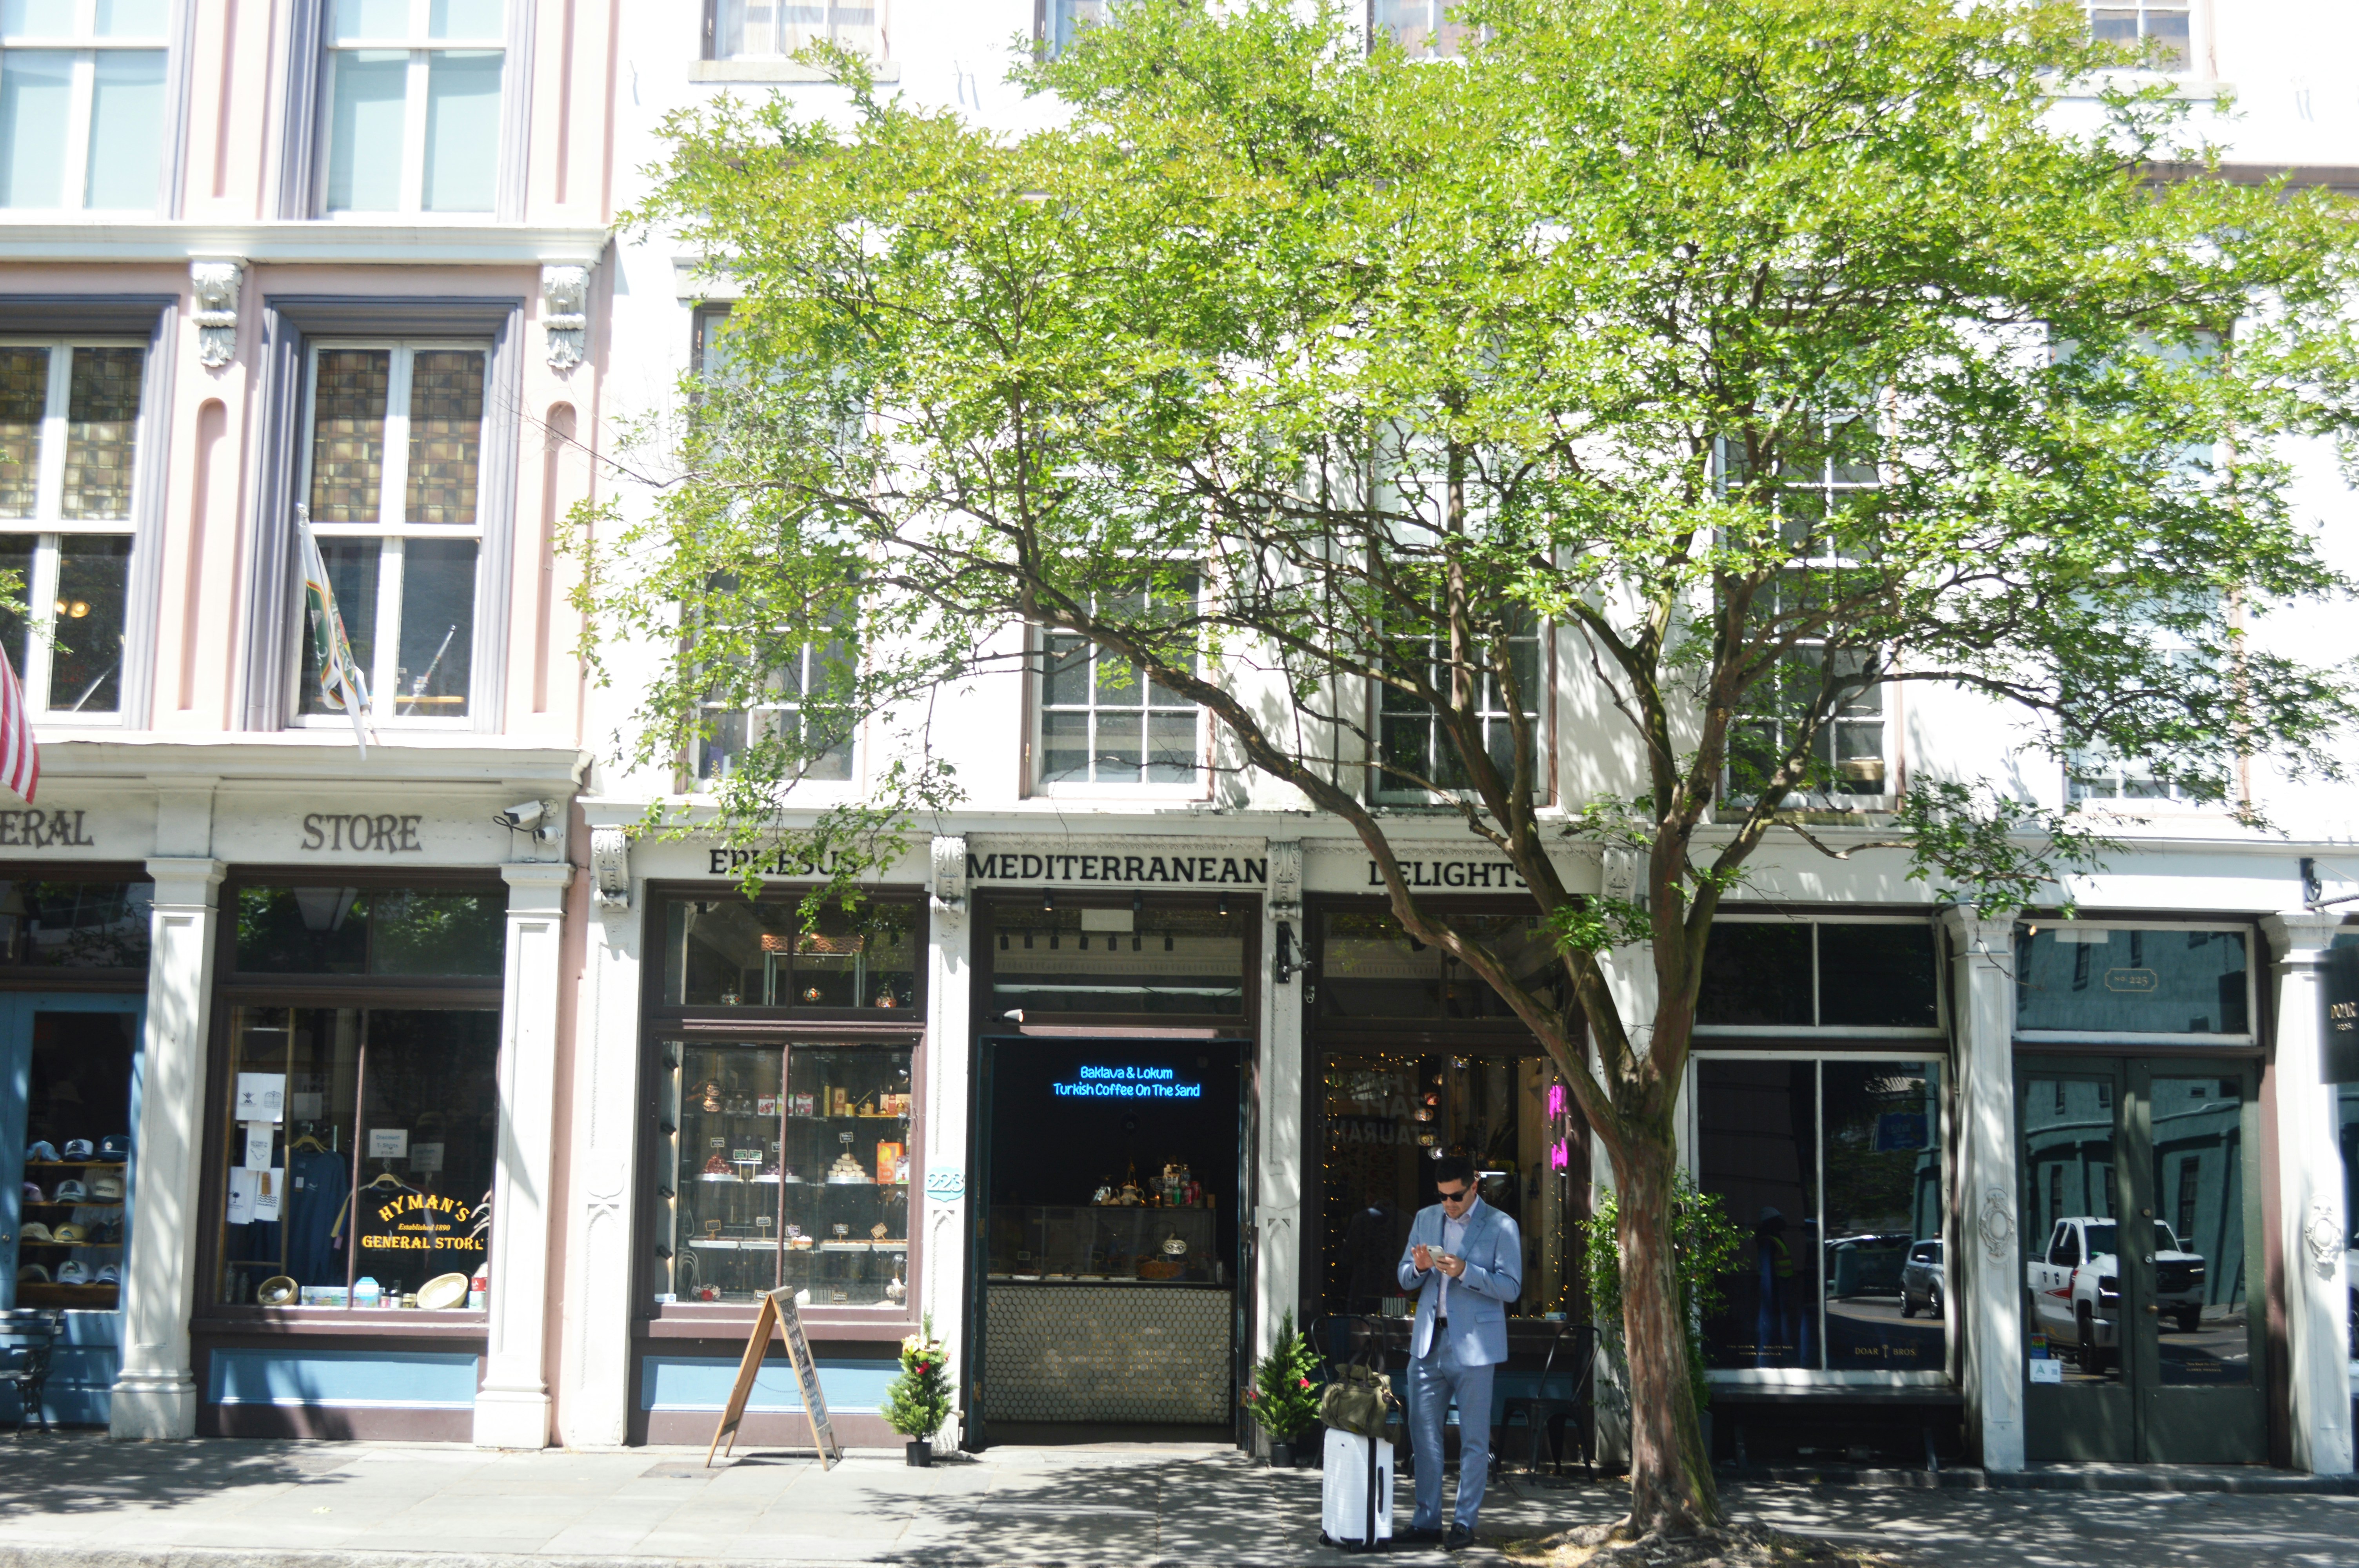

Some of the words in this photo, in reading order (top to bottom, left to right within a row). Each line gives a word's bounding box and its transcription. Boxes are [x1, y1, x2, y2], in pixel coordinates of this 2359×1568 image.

[301, 813, 422, 854] STORE
[966, 854, 1267, 883] MEDITERRANEAN
[2129, 976, 2149, 987] 225
[1080, 1066, 1125, 1079] Baklava
[1126, 1066, 1135, 1079] &
[1137, 1067, 1173, 1079] Lokum
[1053, 1081, 1094, 1096] Turkish
[1095, 1083, 1134, 1096] Coffee
[1136, 1083, 1151, 1096] On
[1152, 1084, 1174, 1096] The
[1175, 1083, 1200, 1097] Sand
[927, 1172, 964, 1193] 223
[378, 1194, 470, 1222] HYMAN'S
[362, 1235, 431, 1249] GENERAL
[435, 1237, 484, 1250] STORE
[1892, 1348, 1917, 1356] BROS.
